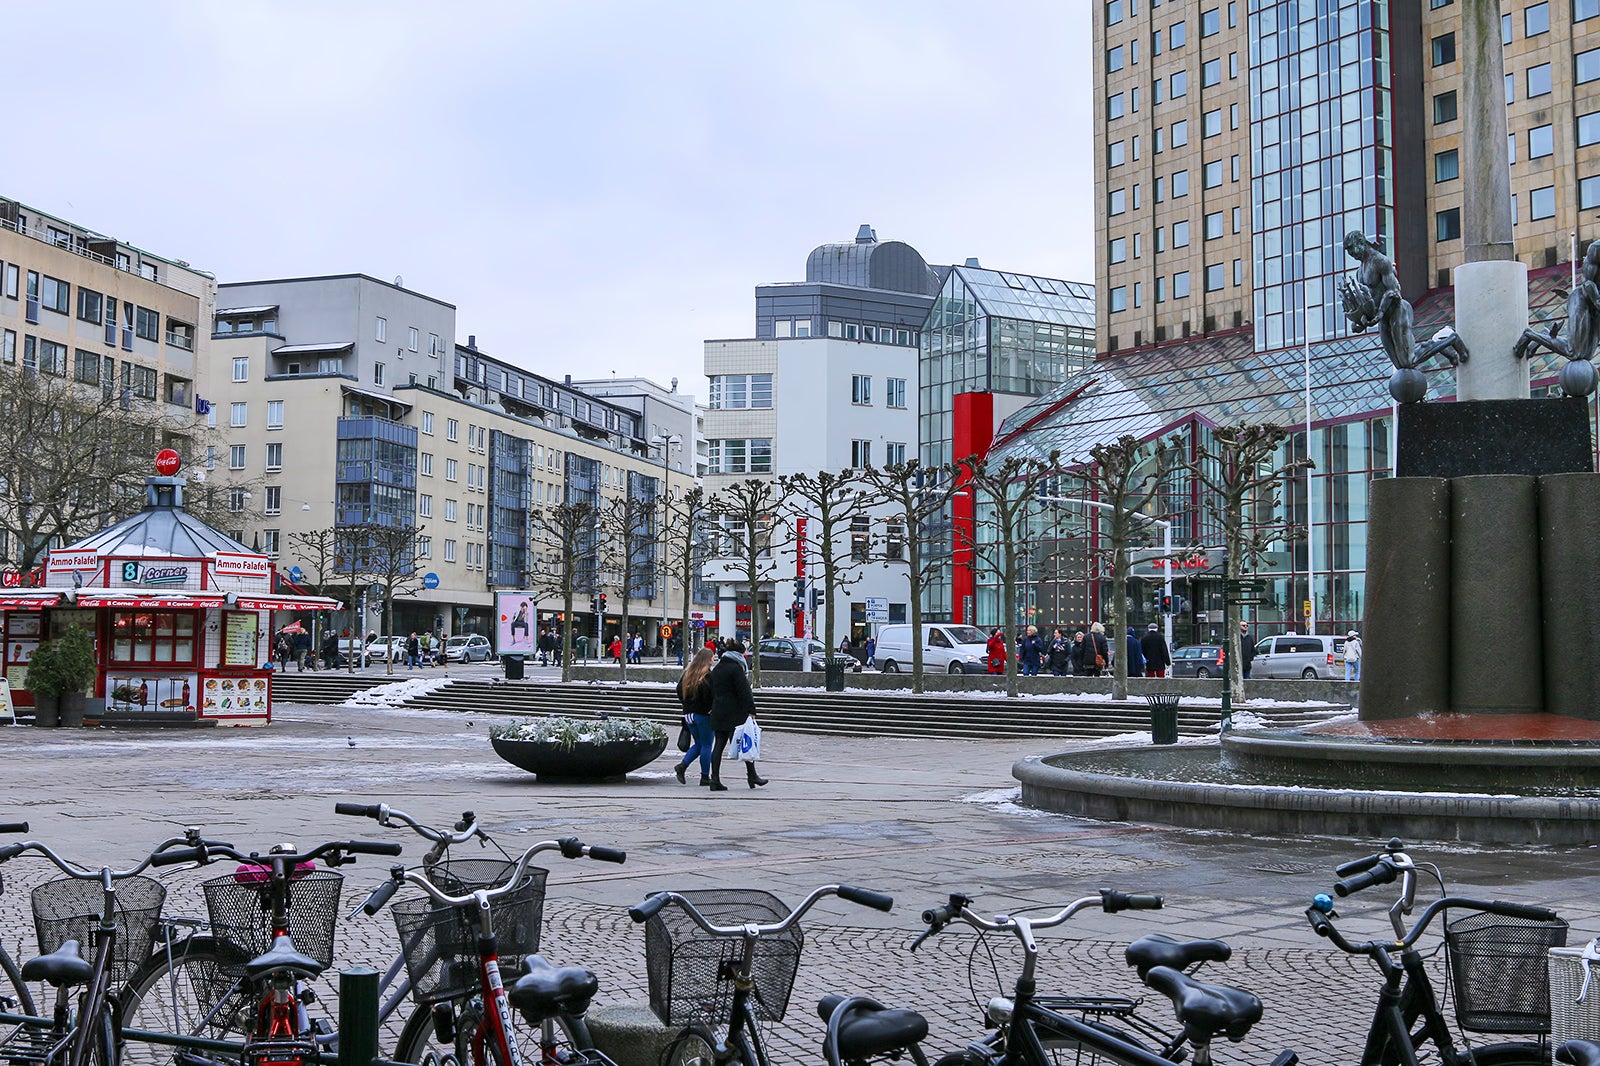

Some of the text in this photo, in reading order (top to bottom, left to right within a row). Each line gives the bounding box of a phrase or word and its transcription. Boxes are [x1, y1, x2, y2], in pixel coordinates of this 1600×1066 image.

[156, 457, 177, 466] Coca-Cola
[51, 556, 96, 566] Ammo Falafel
[217, 559, 267, 571] Ammo Falafel
[124, 563, 187, 580] 8 Corner
[497, 999, 521, 1066] MONARK
